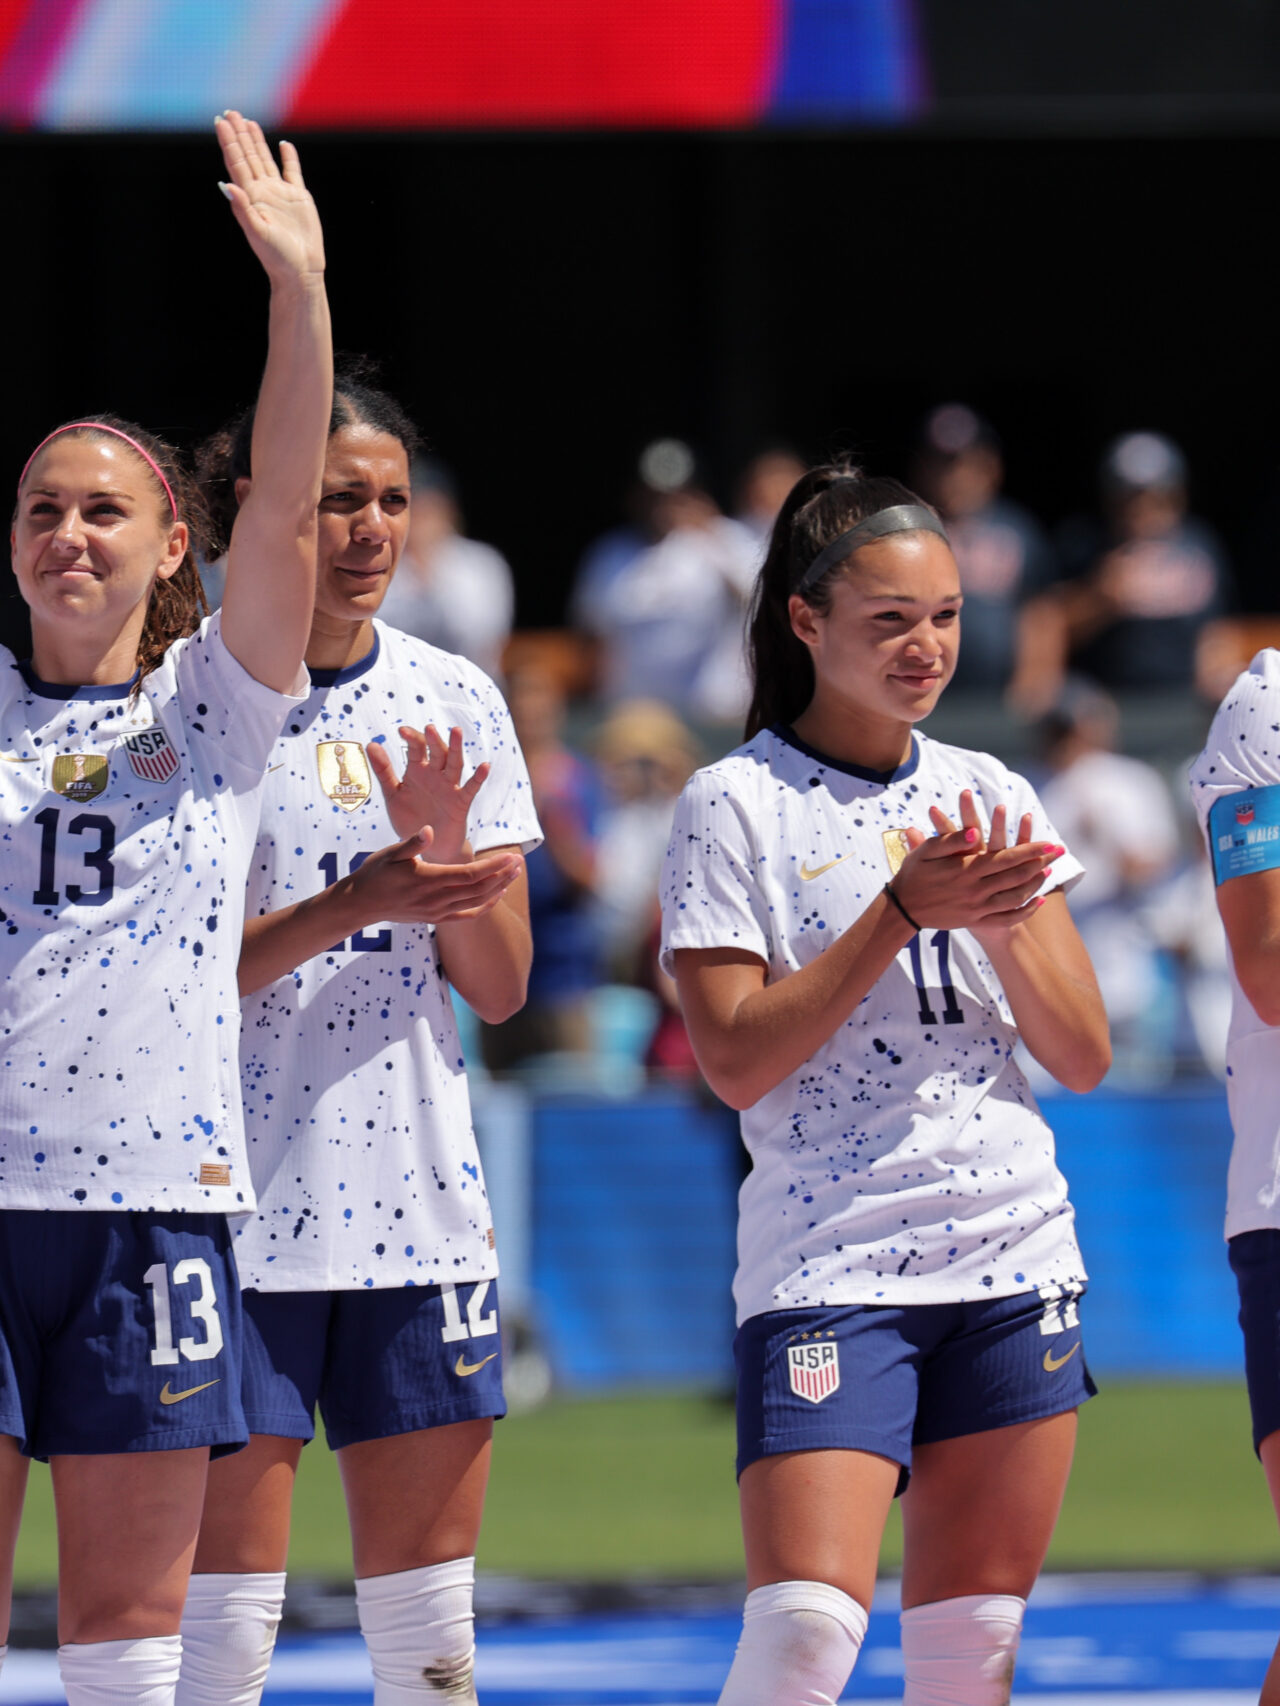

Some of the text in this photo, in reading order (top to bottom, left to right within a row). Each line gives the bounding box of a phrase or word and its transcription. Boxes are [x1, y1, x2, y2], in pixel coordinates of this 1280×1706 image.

[125, 732, 166, 755] USA
[66, 782, 93, 790] FIFA
[334, 784, 359, 794] FIFA
[1247, 826, 1280, 845] WALES
[32, 807, 116, 907] 13
[904, 929, 964, 1025] 11
[143, 1257, 224, 1366] 13
[440, 1281, 498, 1343] 12
[792, 1345, 835, 1369] USA
